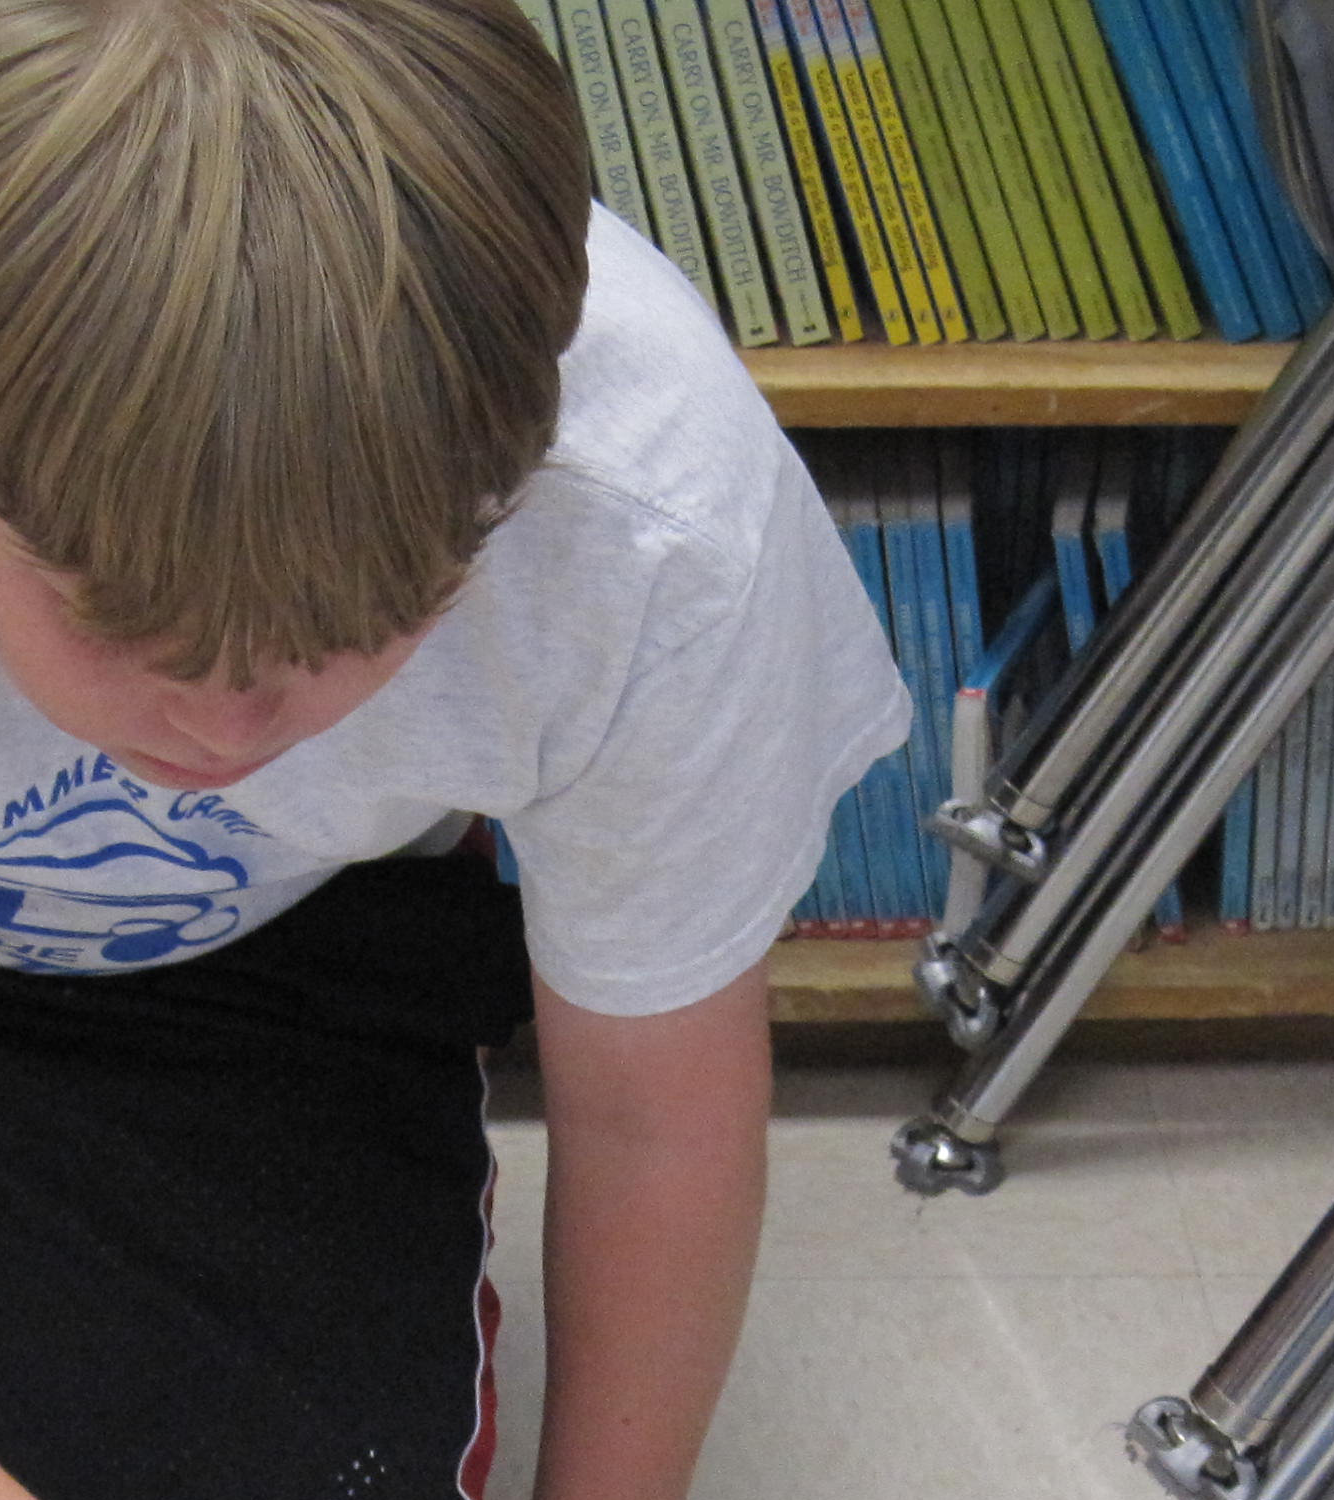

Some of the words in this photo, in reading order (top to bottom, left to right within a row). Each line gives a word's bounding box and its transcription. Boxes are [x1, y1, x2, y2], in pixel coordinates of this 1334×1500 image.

[571, 9, 605, 75] CARRY
[621, 19, 655, 83] CARRY
[673, 23, 704, 88] CARRY
[711, 175, 754, 286] BOWDITCH
[724, 20, 757, 85] CARRY
[763, 174, 807, 283] BOWDITCH
